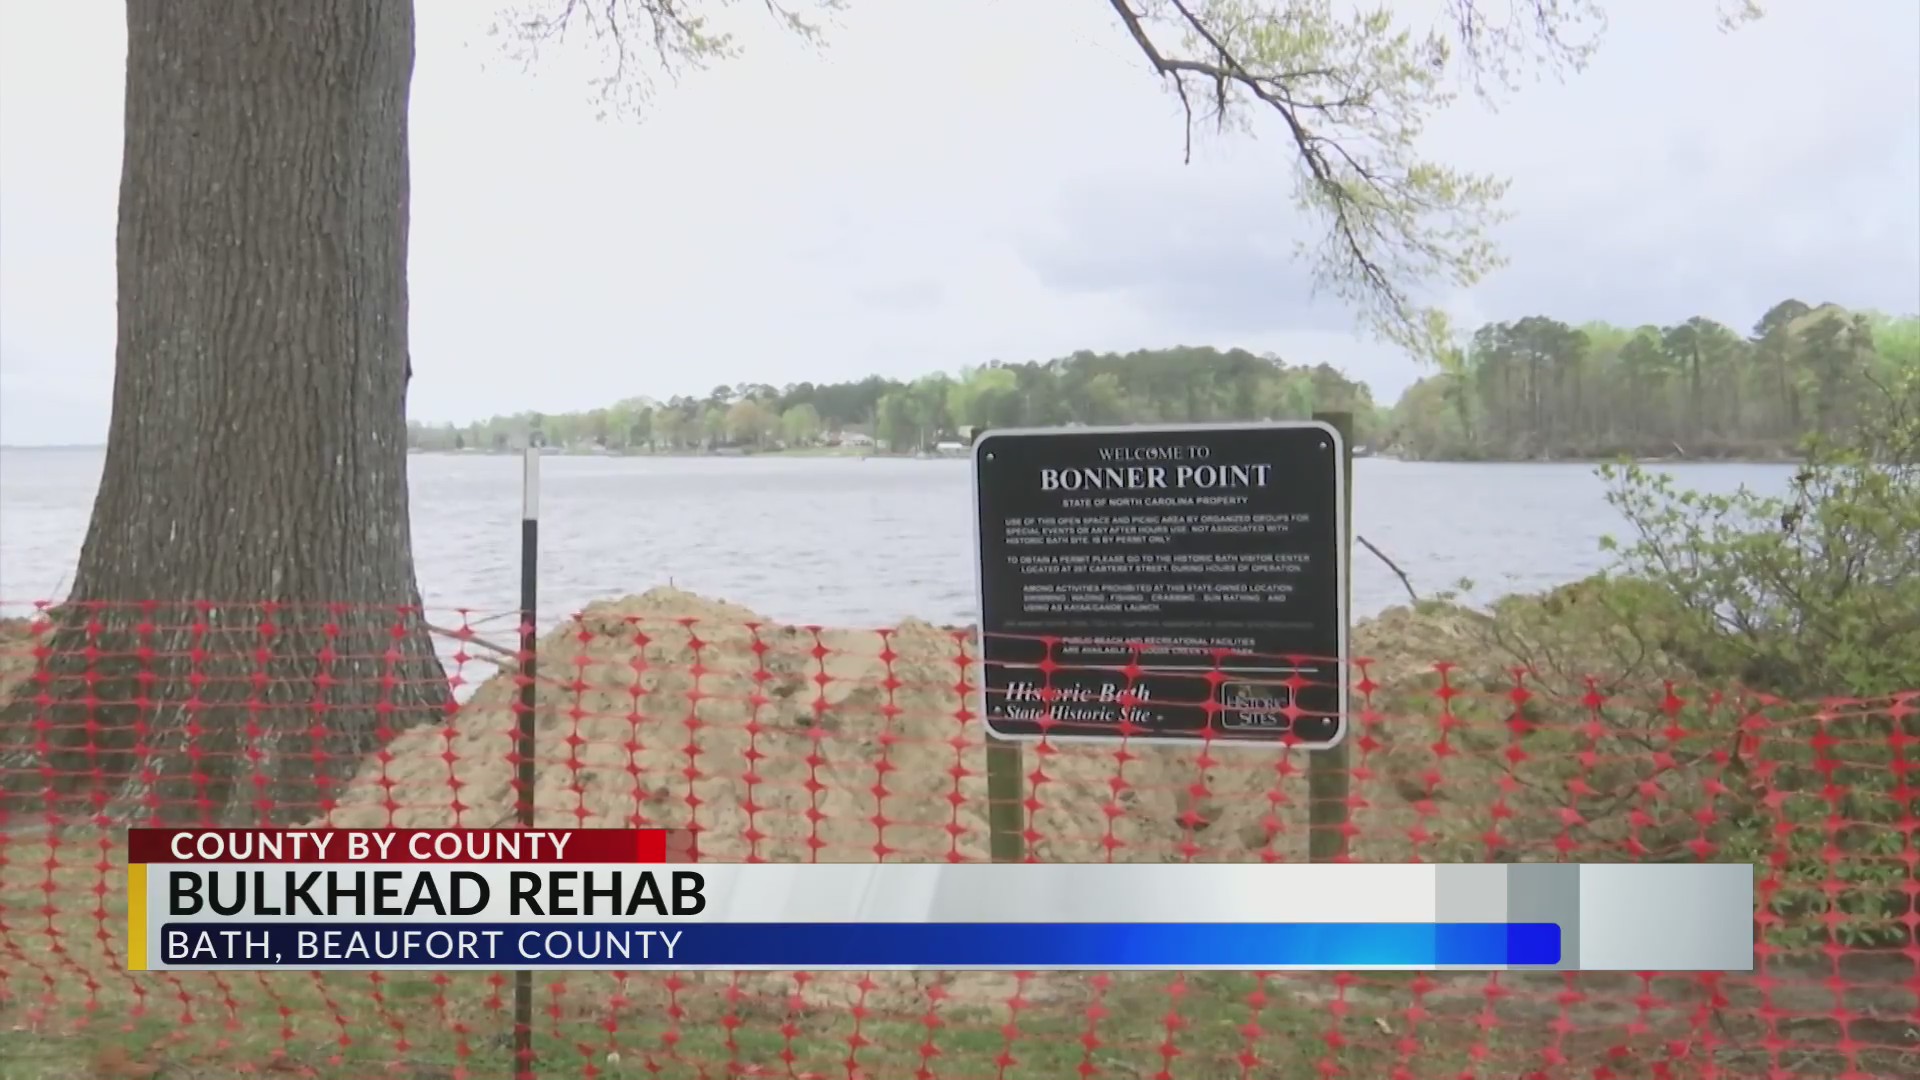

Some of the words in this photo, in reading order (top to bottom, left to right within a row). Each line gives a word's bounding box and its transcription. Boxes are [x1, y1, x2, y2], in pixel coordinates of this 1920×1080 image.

[1099, 447, 1182, 461] WELCOME
[1188, 445, 1210, 459] TO
[1041, 467, 1167, 490] BONNER
[1177, 465, 1271, 488] POINT
[1062, 499, 1092, 508] STATE
[1093, 499, 1107, 507] OF
[1108, 498, 1143, 506] NORTH
[1144, 496, 1194, 506] CAROLINA
[1195, 496, 1249, 505] PROPERTY
[1005, 518, 1022, 526] USE
[1023, 518, 1035, 526] OF
[1037, 517, 1056, 525] THIS
[1057, 517, 1081, 525] OPEN
[1082, 516, 1110, 525] SPACE
[1111, 516, 1130, 524] AND
[1160, 515, 1185, 524] AREA
[1186, 515, 1198, 523] BY
[1200, 514, 1250, 523] ORGANIZED
[1252, 514, 1289, 522] GROUPS
[1291, 513, 1310, 522] FOR
[1006, 527, 1040, 535] SPECIAL
[1076, 526, 1089, 534] OR
[1090, 526, 1108, 534] ANY
[1109, 526, 1137, 534] AFTER
[1138, 525, 1169, 533] HOURS
[1191, 525, 1209, 533] NOT
[1210, 524, 1265, 532] ASSOCIATED
[1266, 524, 1289, 532] WITH
[1006, 537, 1044, 545] HISTORIC
[1046, 536, 1069, 544] BATH
[1102, 536, 1115, 544] BY
[1116, 535, 1147, 543] PERMIT
[1007, 556, 1018, 564] TO
[1059, 555, 1090, 563] PERMIT
[1092, 555, 1125, 563] PLEASE
[1173, 554, 1213, 562] HISTORIC
[1215, 554, 1238, 562] BATH
[1021, 565, 1059, 573] LOCATED
[1060, 565, 1072, 573] AT
[1171, 564, 1203, 572] DURING
[1205, 564, 1236, 572] HOURS
[1100, 584, 1153, 592] PROHIBITED
[1153, 584, 1165, 592] AT
[1062, 636, 1094, 644] PUBLIC
[1144, 637, 1208, 645] RECREATIONAL
[1209, 637, 1256, 646] FACILITIES
[1062, 646, 1079, 654] ARE
[1081, 646, 1125, 654] AVAILABLE
[1005, 682, 1091, 702] Hisoric
[1005, 704, 1043, 720] State
[1049, 704, 1114, 721] Historic
[1119, 706, 1150, 722] Site
